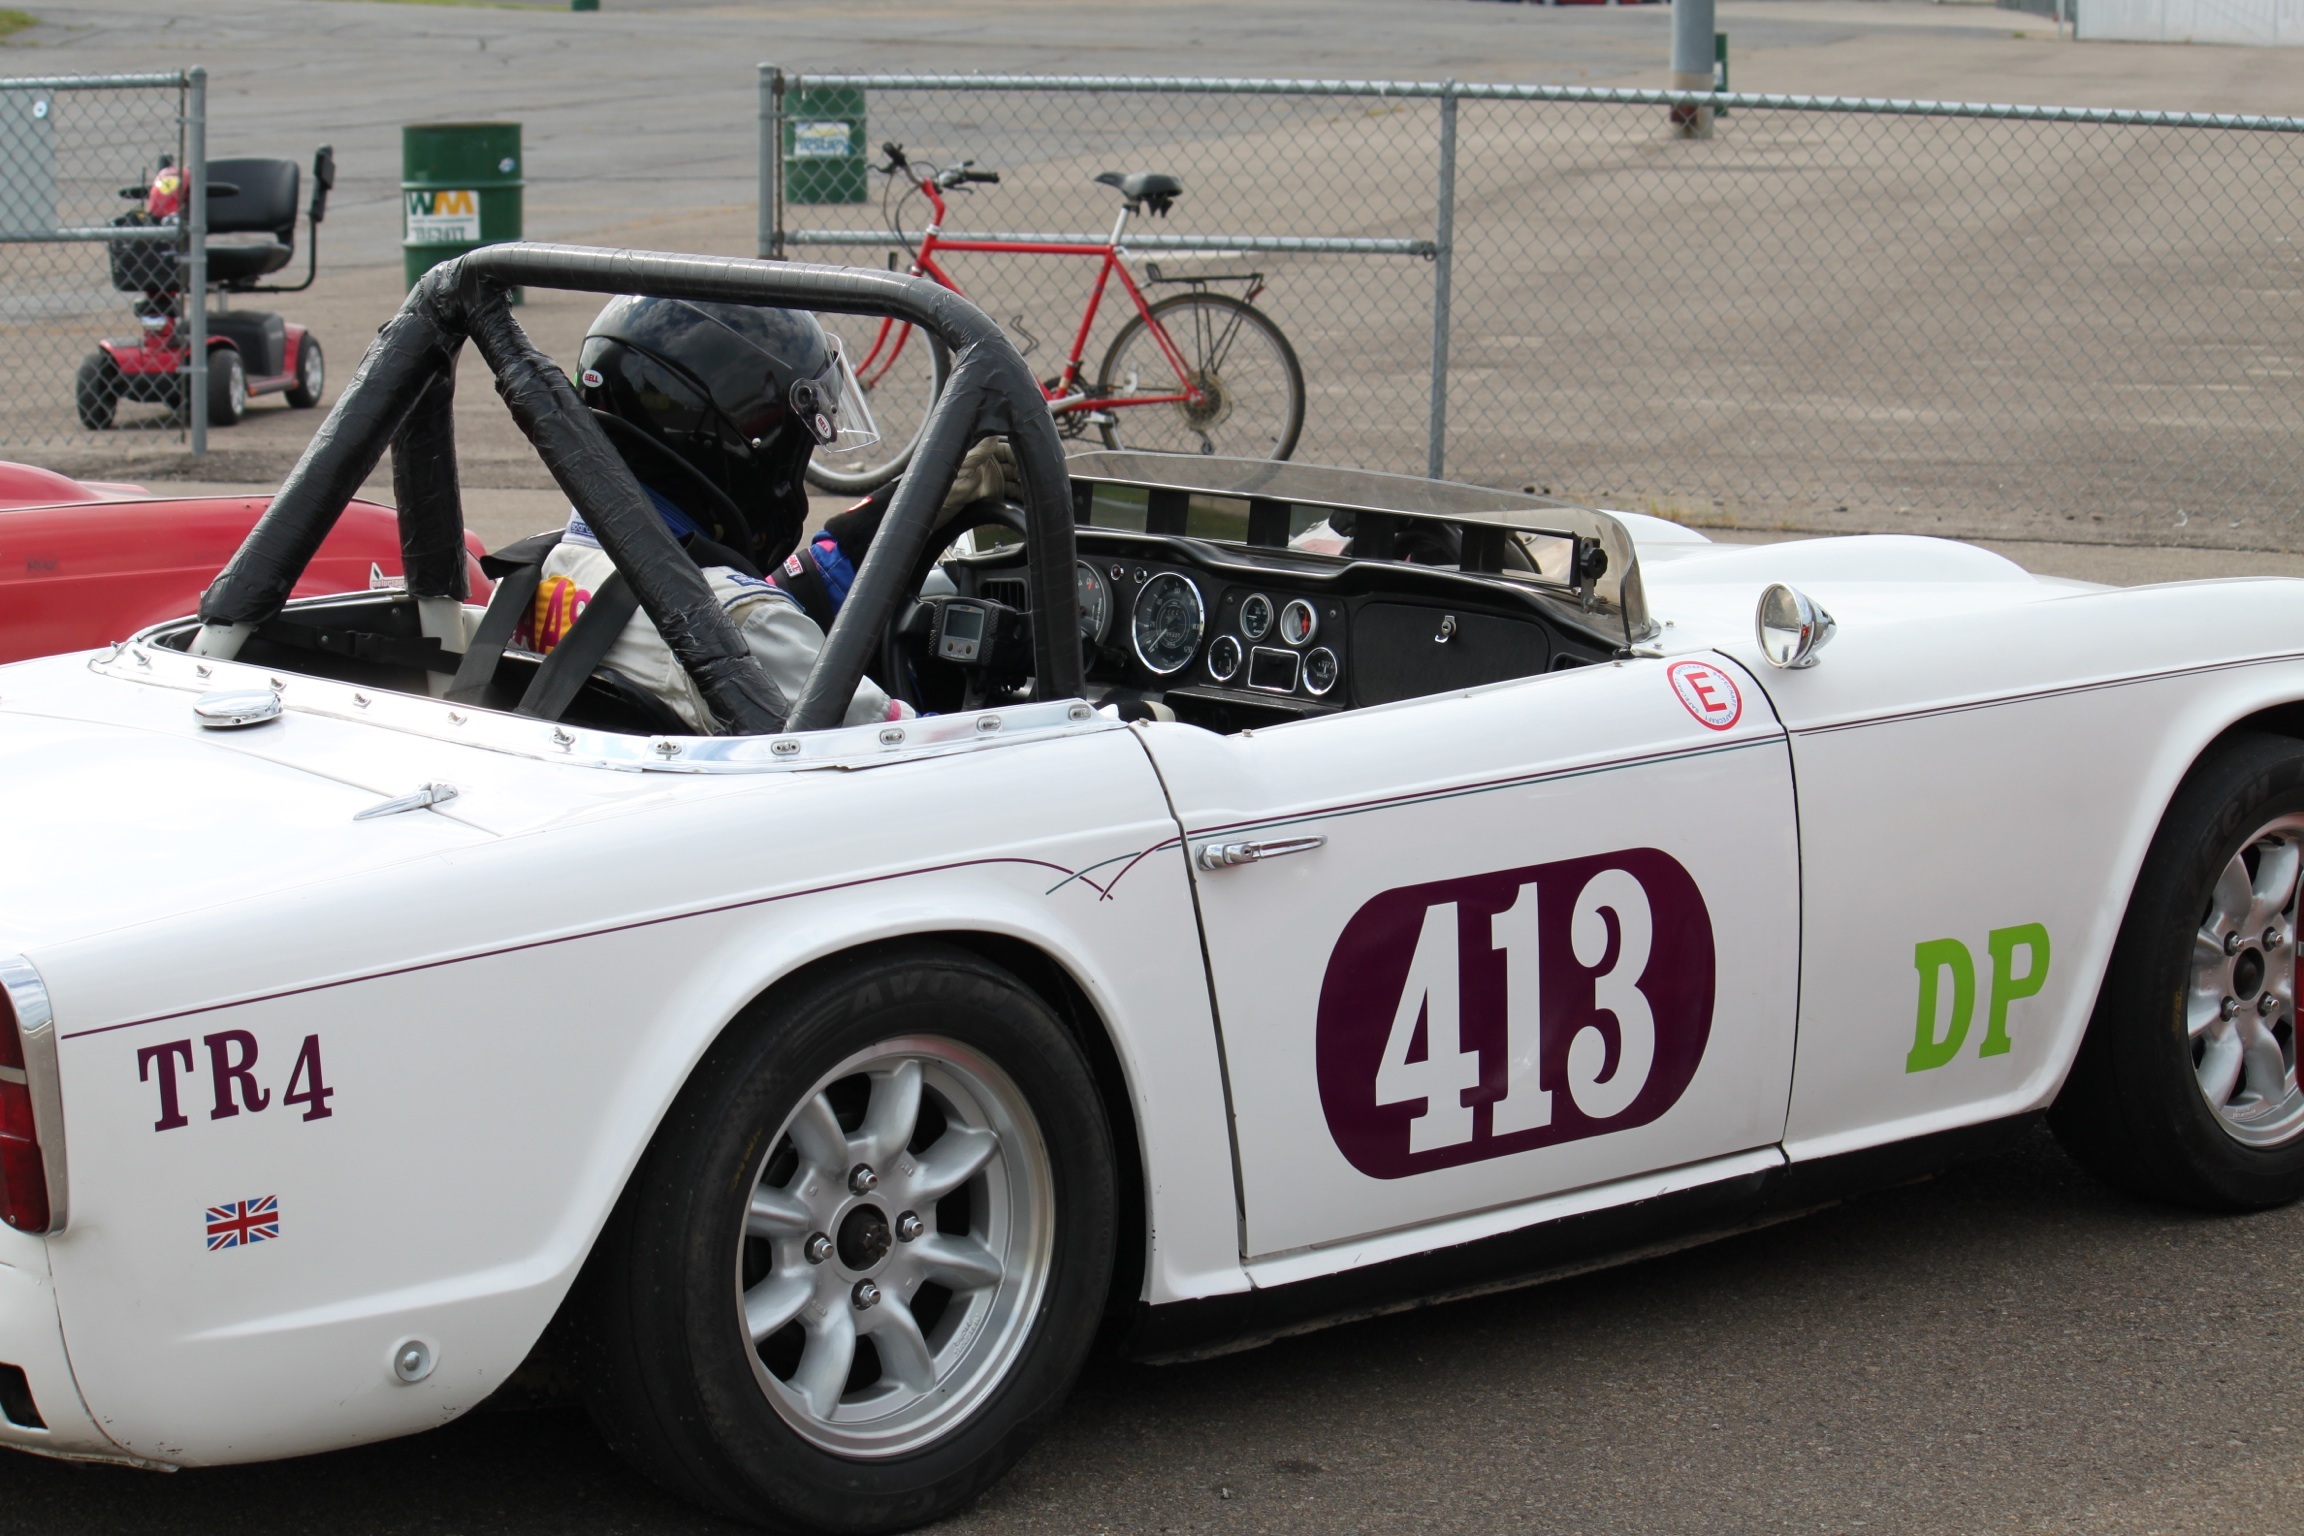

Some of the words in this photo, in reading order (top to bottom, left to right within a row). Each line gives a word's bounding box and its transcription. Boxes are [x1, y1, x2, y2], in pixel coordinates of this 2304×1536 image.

[409, 190, 474, 216] WM
[585, 373, 599, 384] BELL
[1684, 672, 1727, 712] E
[1375, 868, 1656, 1155] 413
[1905, 922, 2051, 1074] DP
[137, 1029, 334, 1133] TR4
